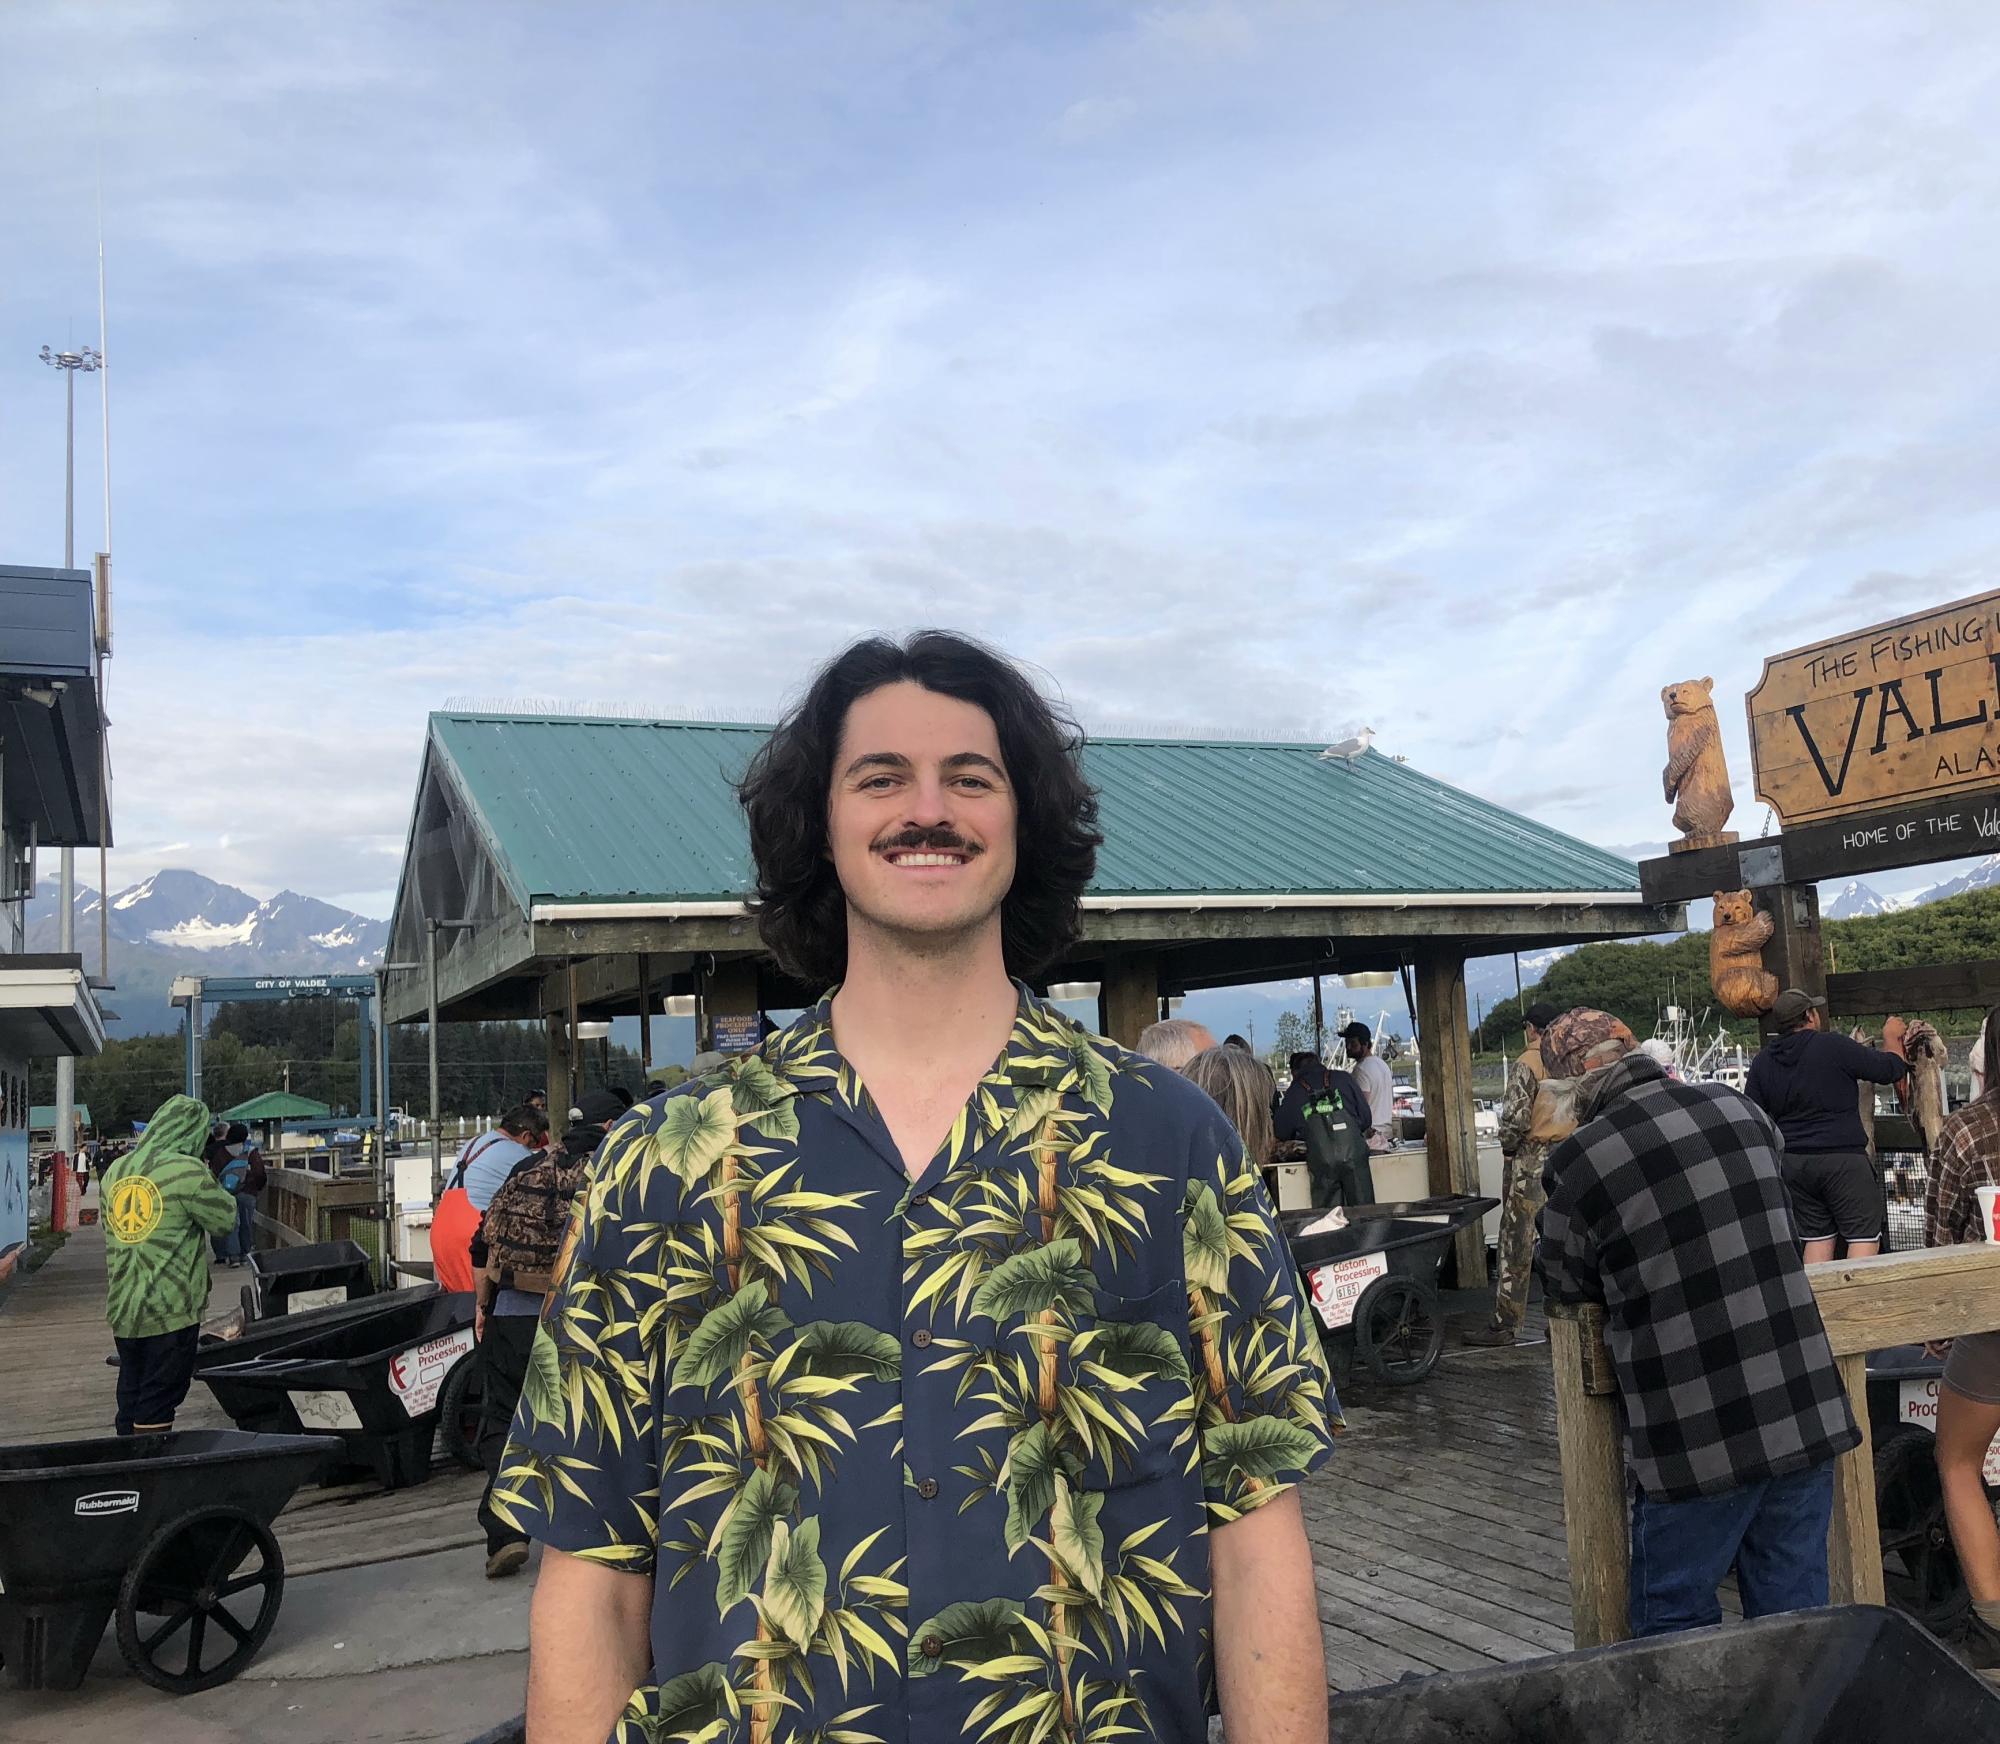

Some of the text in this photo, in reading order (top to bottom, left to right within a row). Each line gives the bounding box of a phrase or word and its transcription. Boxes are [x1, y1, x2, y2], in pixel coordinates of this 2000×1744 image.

[1803, 651, 1858, 688] THE
[1870, 617, 1984, 673] FISHING
[1842, 826, 1889, 850] HOME
[1895, 821, 1917, 841] OF
[1925, 813, 1962, 835] THE
[255, 979, 327, 989] CITY OF VALDEZ
[1332, 1258, 1368, 1274] Custom
[1334, 1265, 1381, 1284] Processing
[417, 1335, 455, 1355] Custom
[418, 1342, 468, 1367] Processing
[78, 1496, 136, 1510] Rubbermaid
